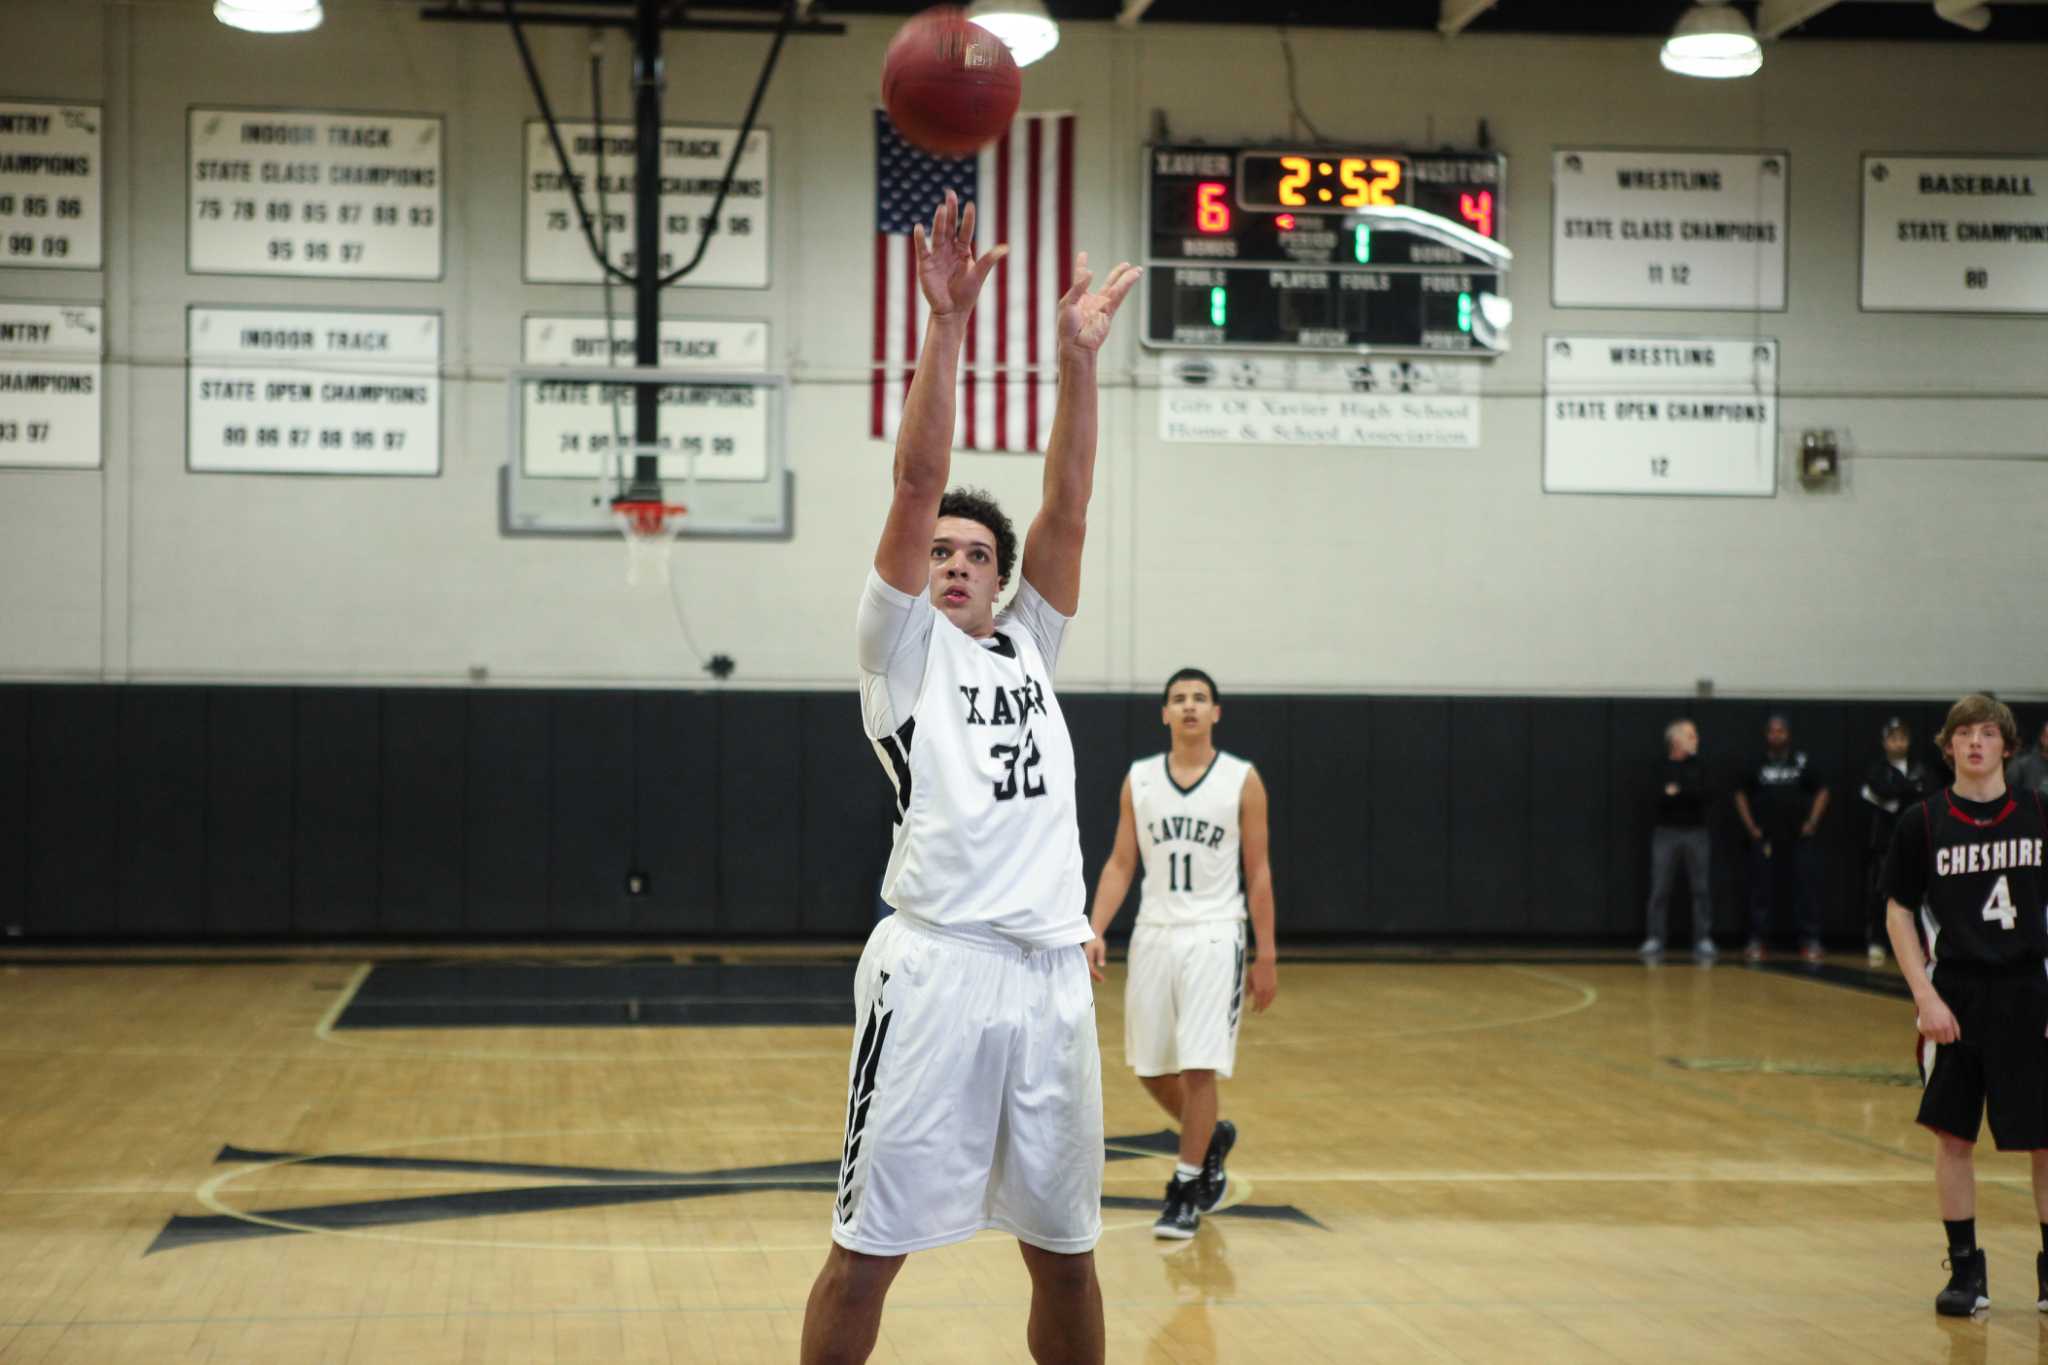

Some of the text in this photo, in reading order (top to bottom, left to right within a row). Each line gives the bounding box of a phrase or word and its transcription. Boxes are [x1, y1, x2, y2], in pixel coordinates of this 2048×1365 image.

[241, 123, 391, 148] INDOOR TRACK
[662, 140, 720, 158] TRACK
[0, 155, 89, 176] AMPIONS
[196, 161, 435, 188] STATE CLASS CHAMPIONS
[1156, 154, 1231, 176] XAVIER
[1279, 156, 1401, 207] 2:52
[1617, 170, 1722, 191] WRESTLING
[1919, 175, 2036, 196] BASEBALL
[198, 200, 222, 220] 75
[1197, 183, 1229, 233] 6
[1459, 191, 1492, 238] 4
[1565, 220, 1777, 243] STATE CLASS CHAMPIONS
[1897, 222, 1949, 242] STATE
[1355, 223, 1370, 264] 1
[1269, 271, 1390, 291] PLAYER FOULS
[1421, 275, 1471, 292] FOULS
[1648, 266, 1690, 286] 11 12
[1211, 287, 1226, 326] 1
[1458, 292, 1471, 332] 1
[241, 330, 388, 350] INDOOR TRACK
[662, 340, 717, 357] TRACK
[1610, 347, 1716, 367] WRESTLING
[200, 381, 427, 404] STATE OPEN CHAMPIONS
[1262, 401, 1328, 416] Xavier
[1340, 402, 1392, 420] High
[1402, 403, 1469, 419] School
[1556, 402, 1767, 423] STATE OPEN CHAMPIONS
[1168, 423, 1228, 438] Home
[1272, 425, 1338, 441] School
[1354, 427, 1467, 443] Association
[1651, 458, 1670, 477] 12
[990, 729, 1048, 802] 32
[1937, 838, 2042, 876] CHESHIRE
[1169, 852, 1192, 892] 11
[1982, 874, 2018, 931] 4
